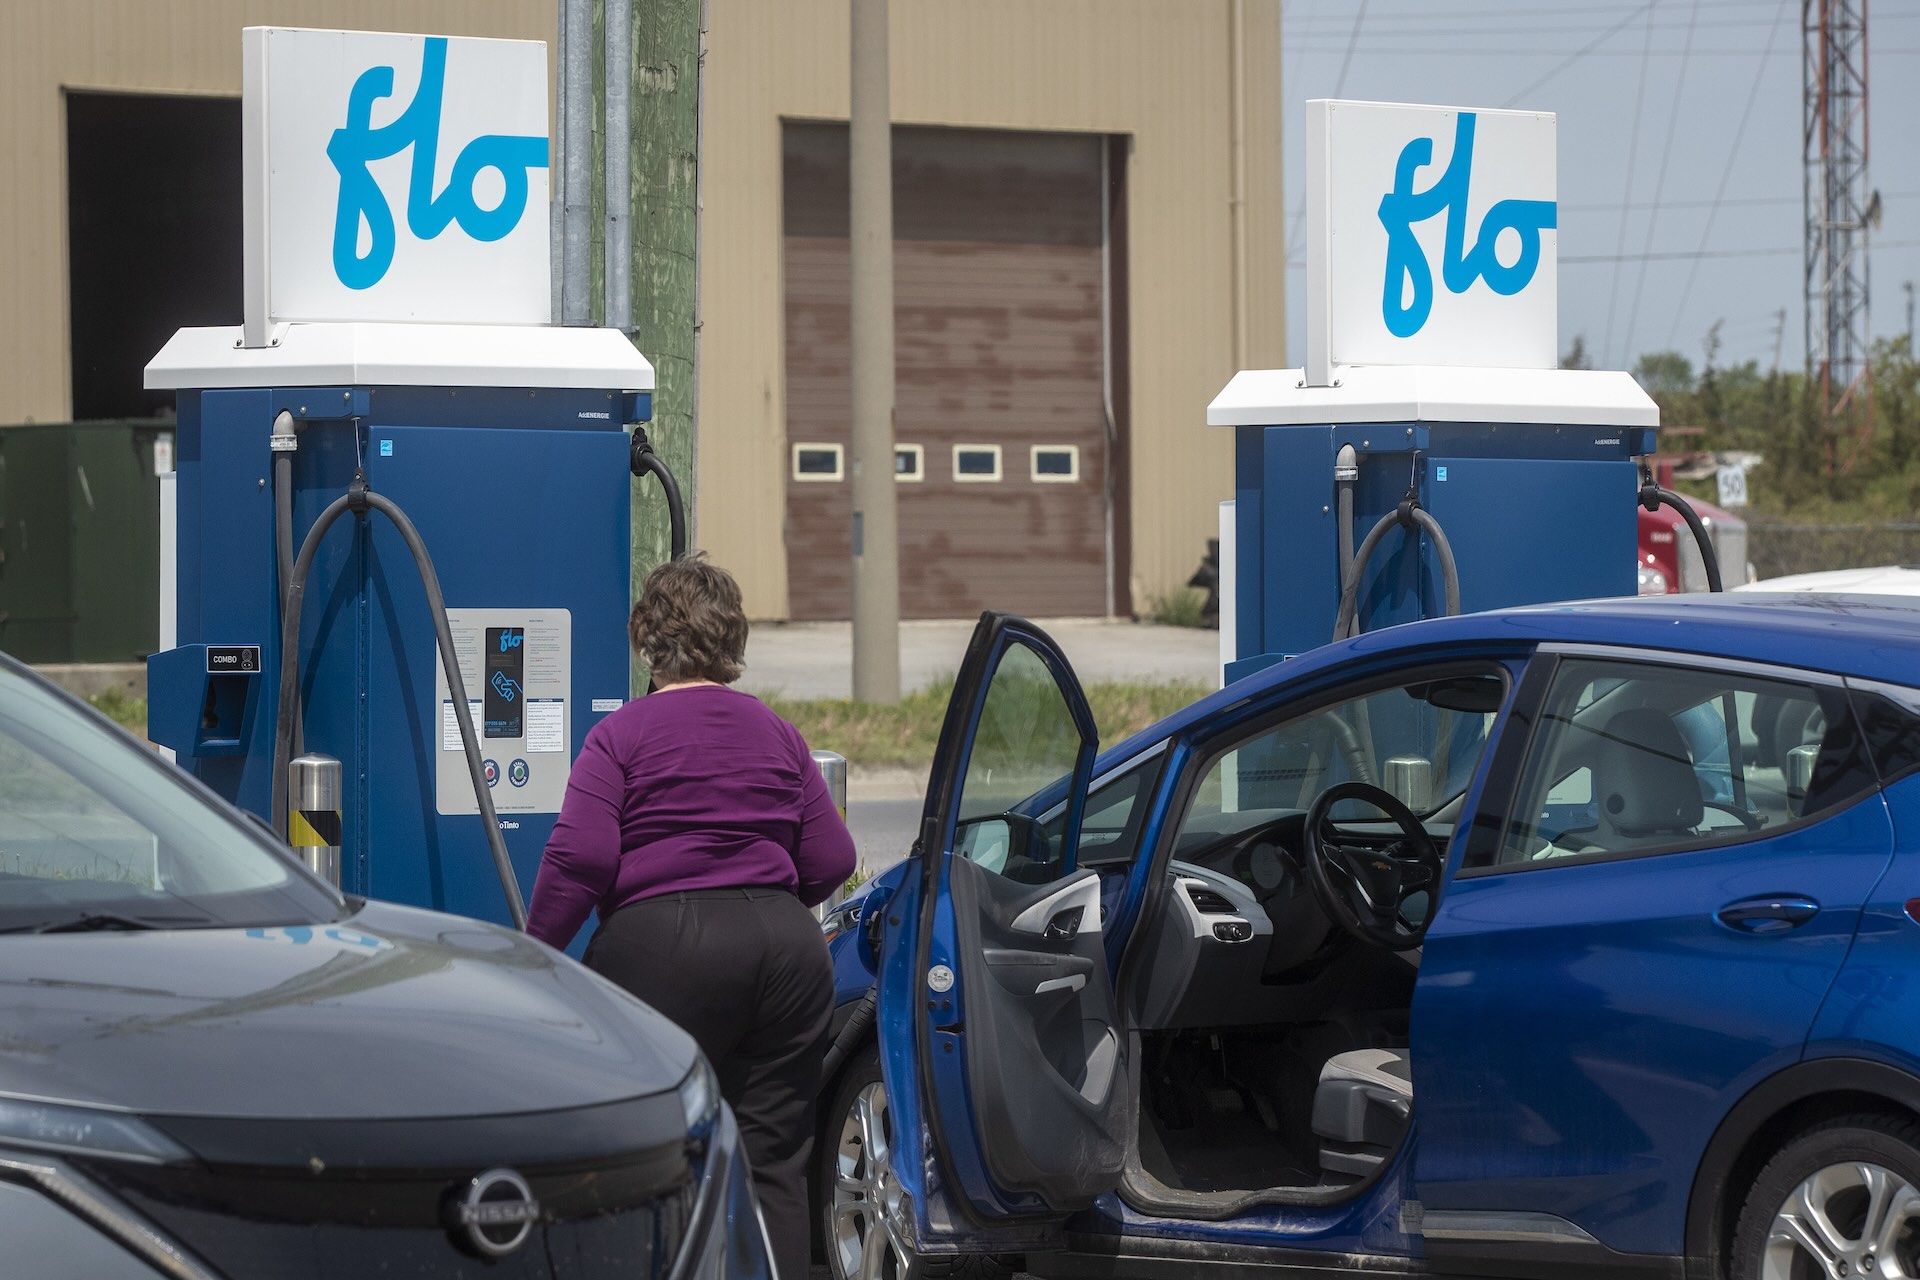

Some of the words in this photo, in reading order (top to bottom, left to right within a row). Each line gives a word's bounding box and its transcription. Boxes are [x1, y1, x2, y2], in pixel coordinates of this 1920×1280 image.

[327, 37, 549, 290] flo
[1378, 112, 1557, 338] flo
[213, 655, 237, 664] COMBO
[500, 628, 525, 652] flo
